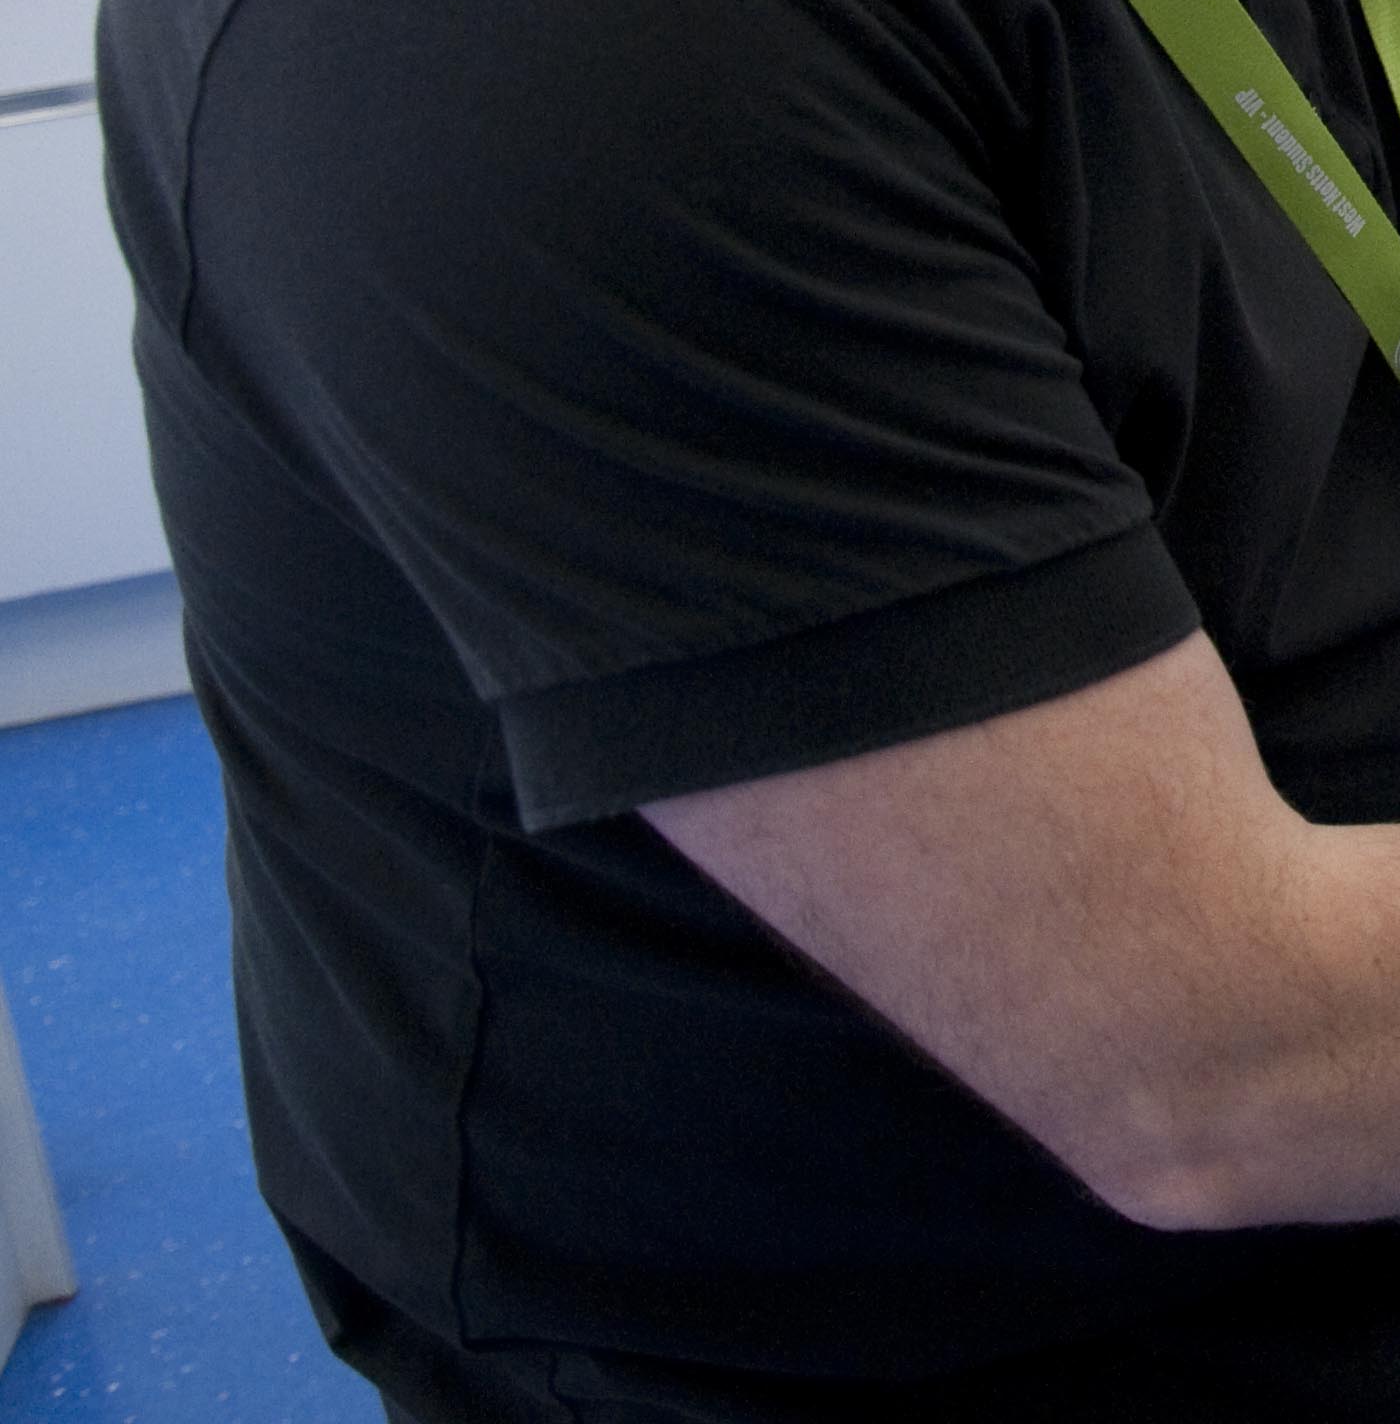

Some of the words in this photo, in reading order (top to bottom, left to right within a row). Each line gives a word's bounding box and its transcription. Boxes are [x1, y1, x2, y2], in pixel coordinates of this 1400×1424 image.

[1235, 88, 1264, 118] VIP
[1261, 113, 1313, 174] Student
[1305, 164, 1342, 207] Notts
[1332, 196, 1366, 238] West
